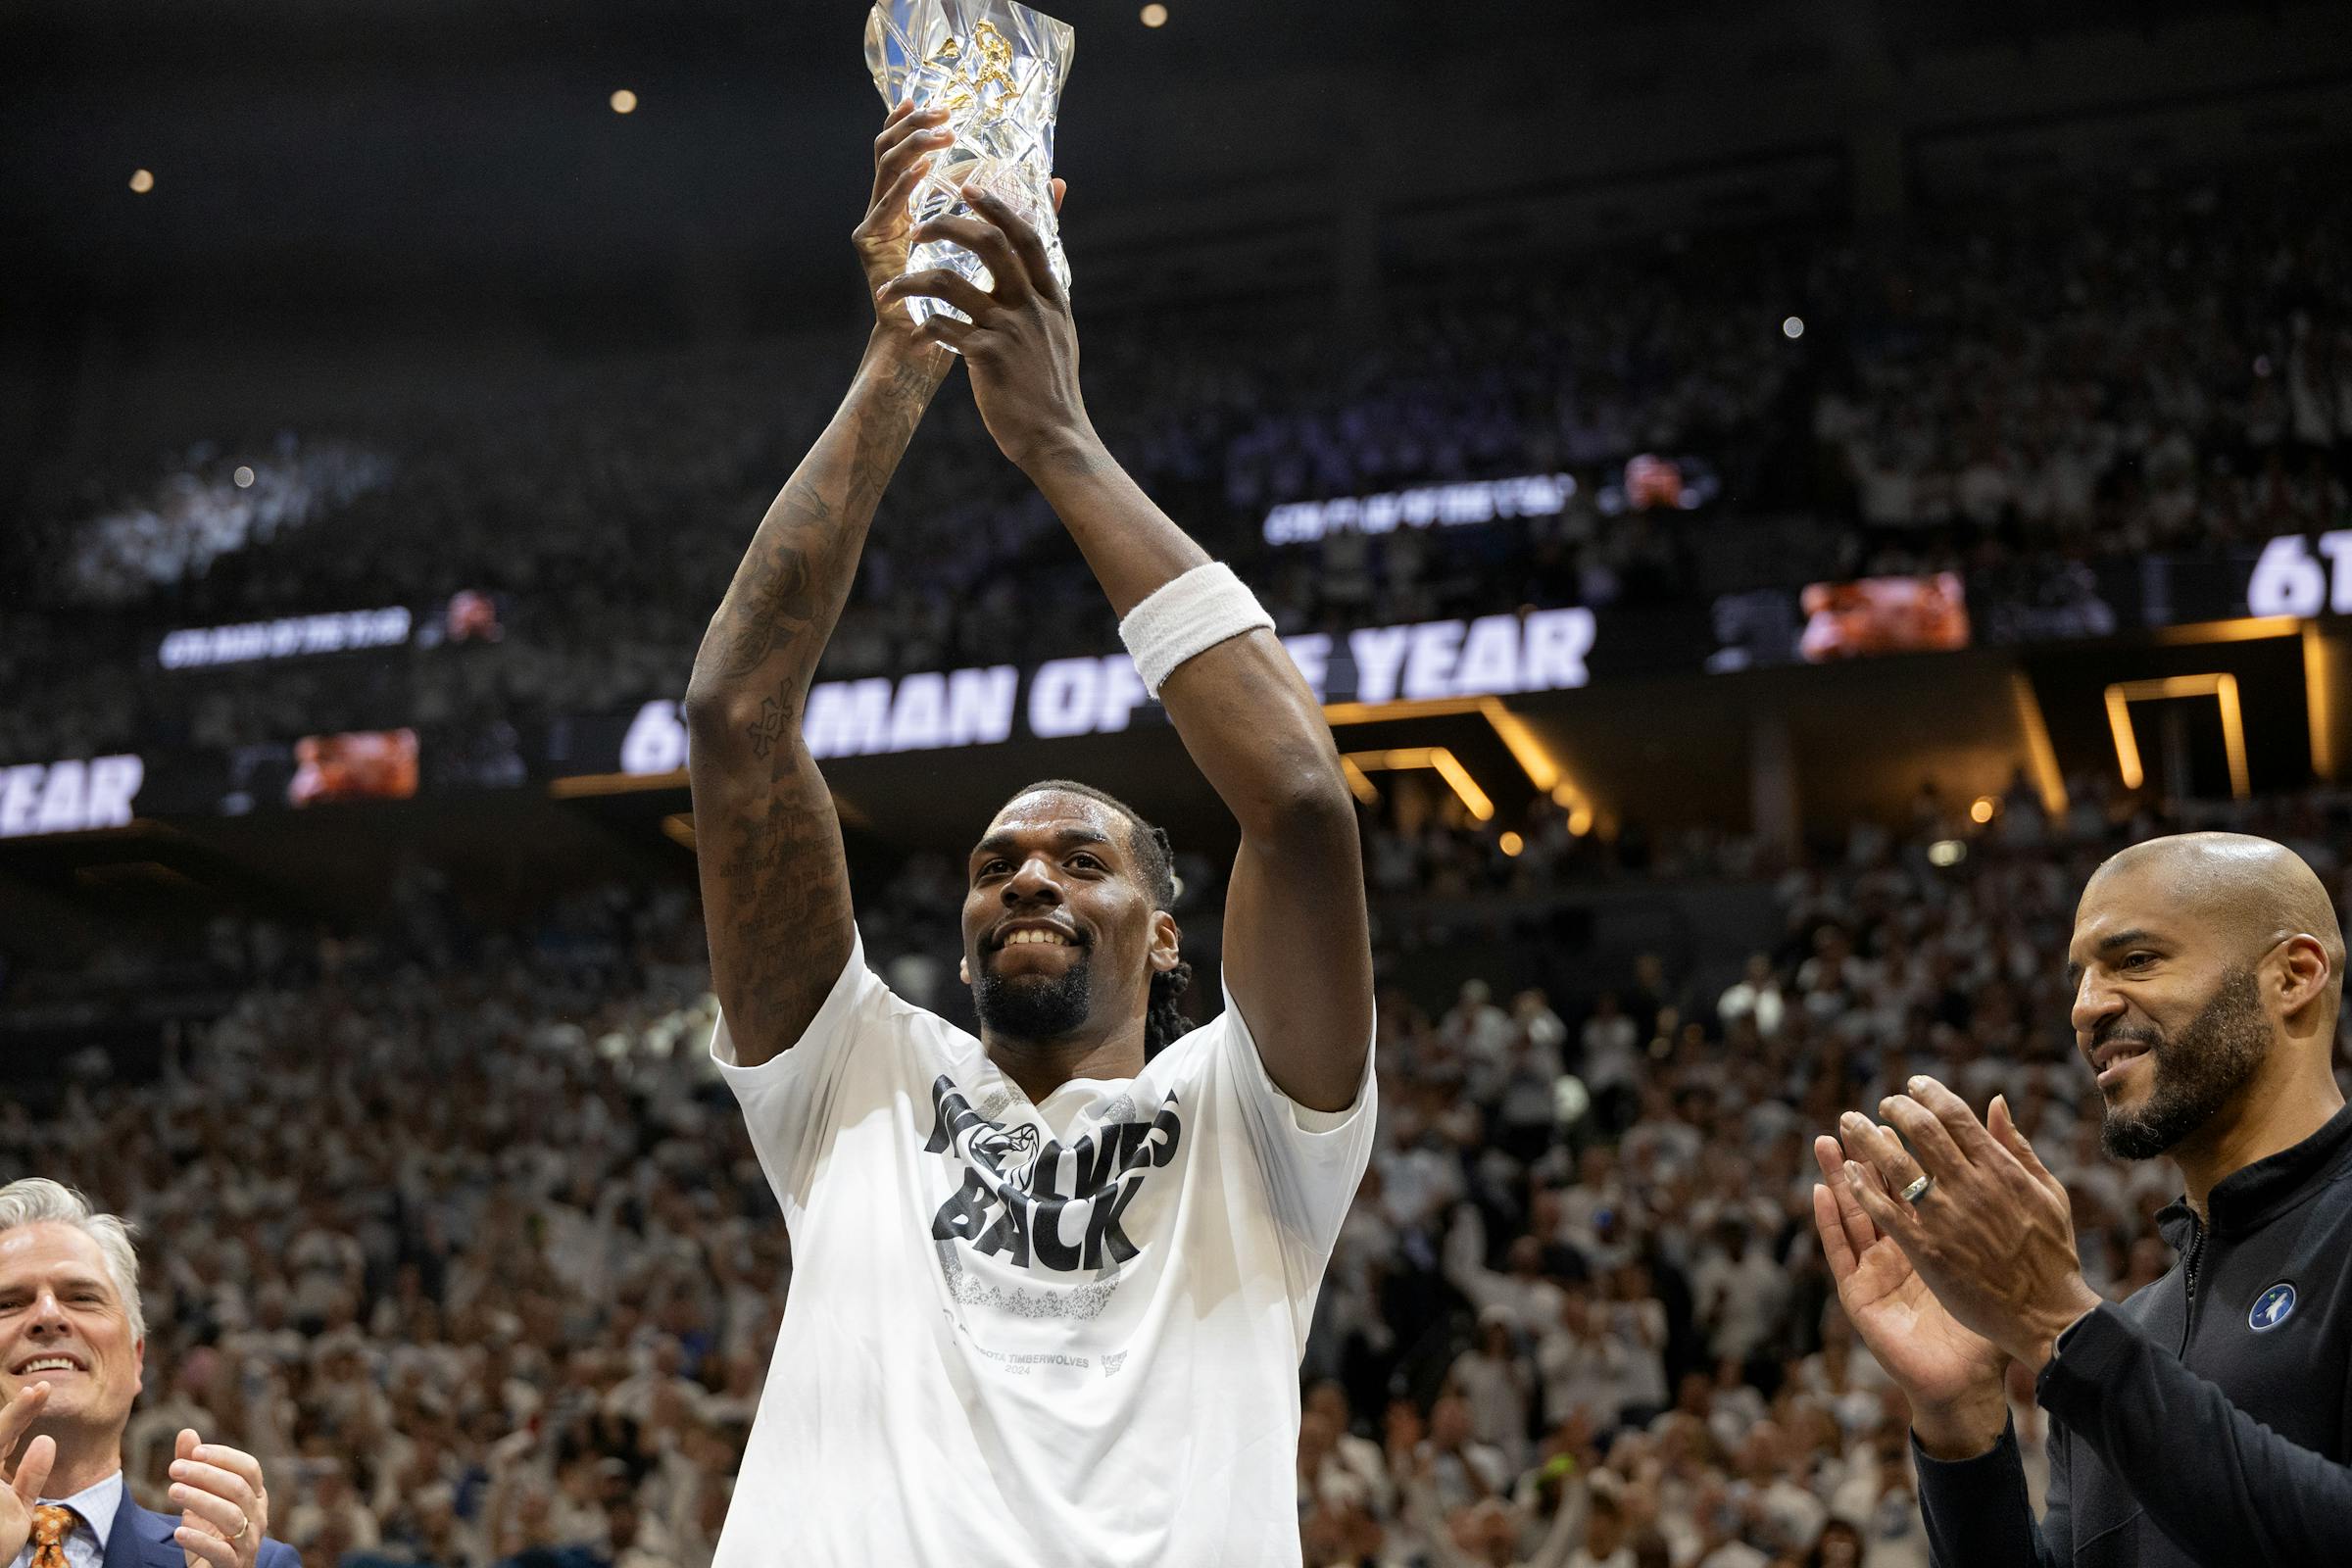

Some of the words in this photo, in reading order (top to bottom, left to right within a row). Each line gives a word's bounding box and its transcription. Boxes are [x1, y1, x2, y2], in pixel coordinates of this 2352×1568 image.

[802, 665, 1019, 760] MAN
[1029, 654, 1150, 739] OF
[1349, 606, 1595, 705] YEAR
[0, 754, 144, 839] EAR
[932, 1167, 1145, 1271] BACK
[1004, 1364, 1031, 1376] 2024
[1008, 1354, 1089, 1369] TIMBERWOLVES
